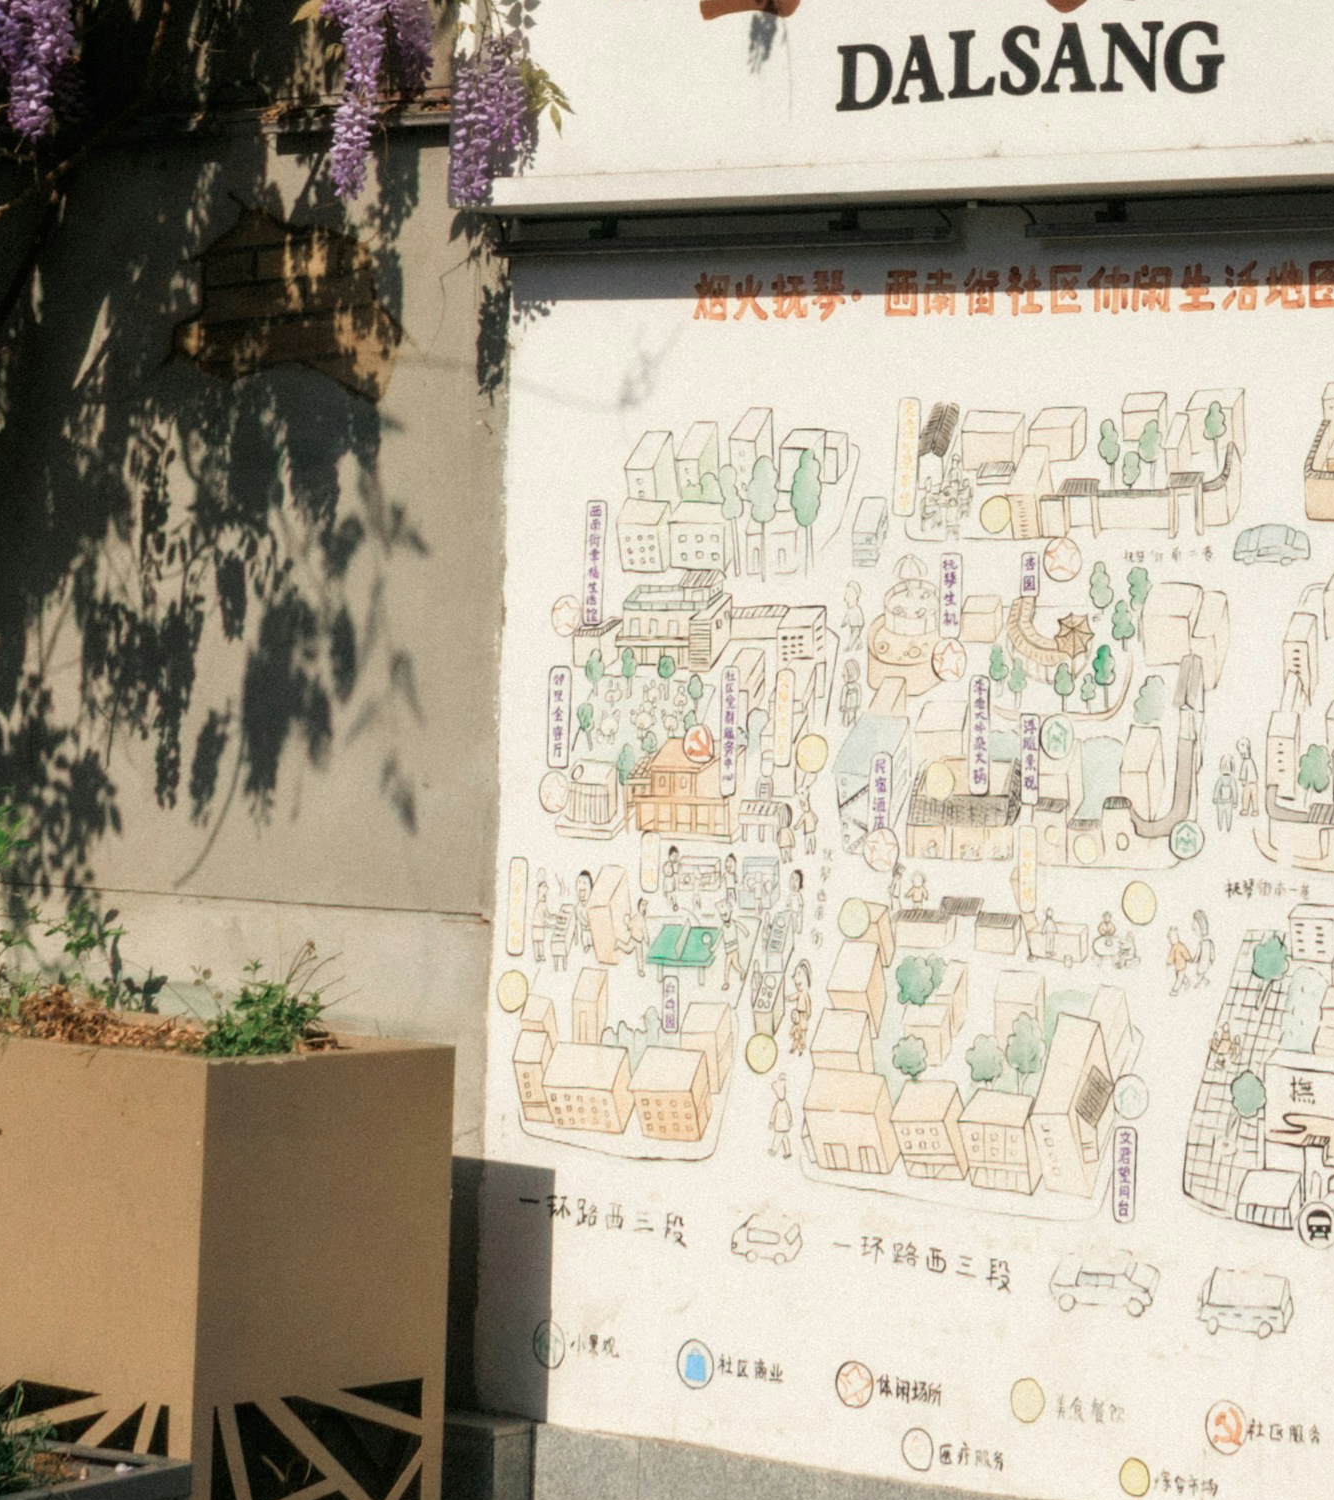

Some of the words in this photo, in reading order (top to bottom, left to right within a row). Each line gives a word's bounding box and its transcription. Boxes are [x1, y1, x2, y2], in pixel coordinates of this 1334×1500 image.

[835, 19, 1227, 115] DALSANG
[519, 1195, 688, 1249] 一环路西三段
[833, 1235, 1012, 1294] 一环路西三段
[717, 1352, 784, 1383] 社区商业
[1246, 1419, 1322, 1445] 社区服务
[938, 1440, 1005, 1472] 医疗服务
